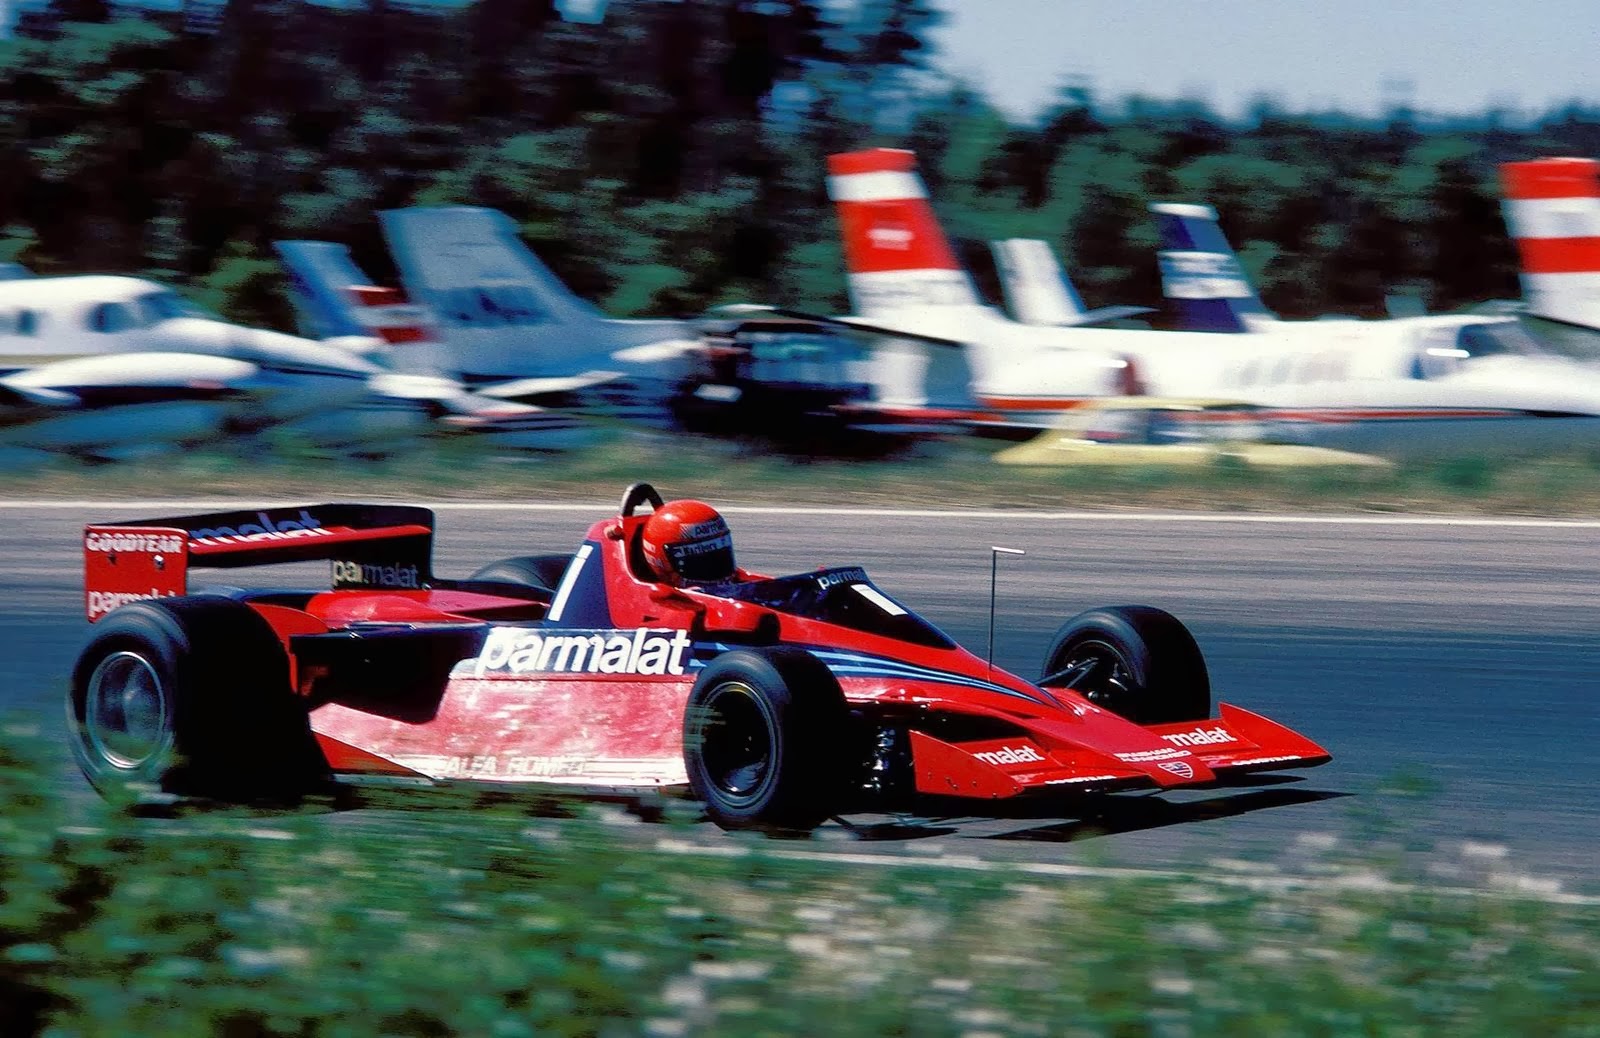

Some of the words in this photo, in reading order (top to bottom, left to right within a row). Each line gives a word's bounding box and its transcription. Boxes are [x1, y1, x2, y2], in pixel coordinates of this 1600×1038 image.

[86, 532, 183, 553] GOODYEAR
[188, 511, 334, 547] malat
[474, 628, 691, 676] parmalat
[1160, 726, 1238, 747] malat
